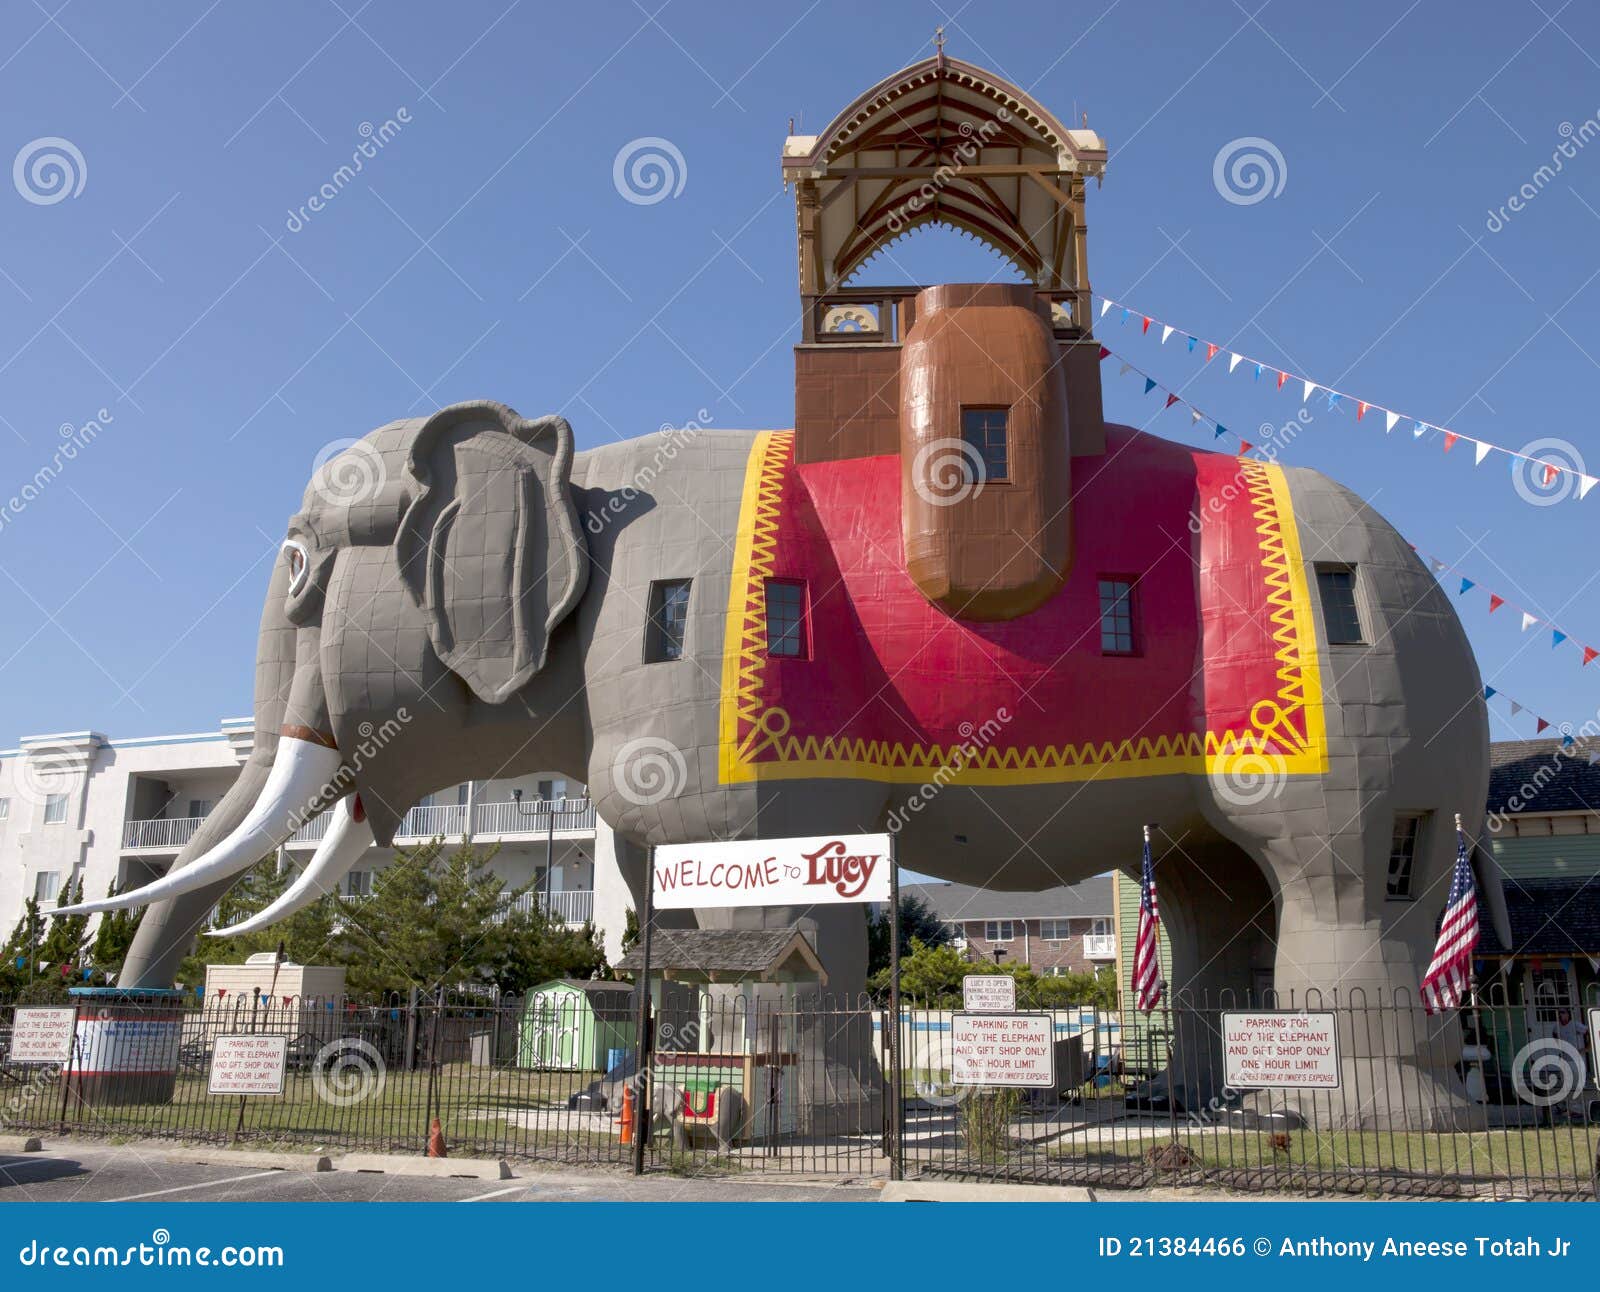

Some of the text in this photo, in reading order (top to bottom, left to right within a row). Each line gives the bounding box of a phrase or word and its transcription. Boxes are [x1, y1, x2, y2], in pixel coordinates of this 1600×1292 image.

[656, 840, 882, 898] WELCOME TO Lucy
[972, 1020, 1028, 1030] PARKING FOR
[1246, 1019, 1309, 1028] PARKING FOR
[956, 1033, 1045, 1043] LUCY THE ELEPHANT
[1228, 1032, 1329, 1042] LUCY THE ELEPHANT
[228, 1040, 268, 1048] PARKING FOR
[216, 1051, 280, 1059] LUCY THE ELEPHANT
[955, 1046, 1047, 1056] AND GIFT SHOP ONLY
[1228, 1046, 1331, 1056] AND GIFT SHOP ONLY
[214, 1061, 280, 1069] AND GIFT SHOP ONLY
[967, 1059, 1036, 1069] ONE HOUR LIMIT
[1241, 1060, 1319, 1069] ONE HOUR LIMIT
[220, 1072, 270, 1080] ONE HOUR LIMIT
